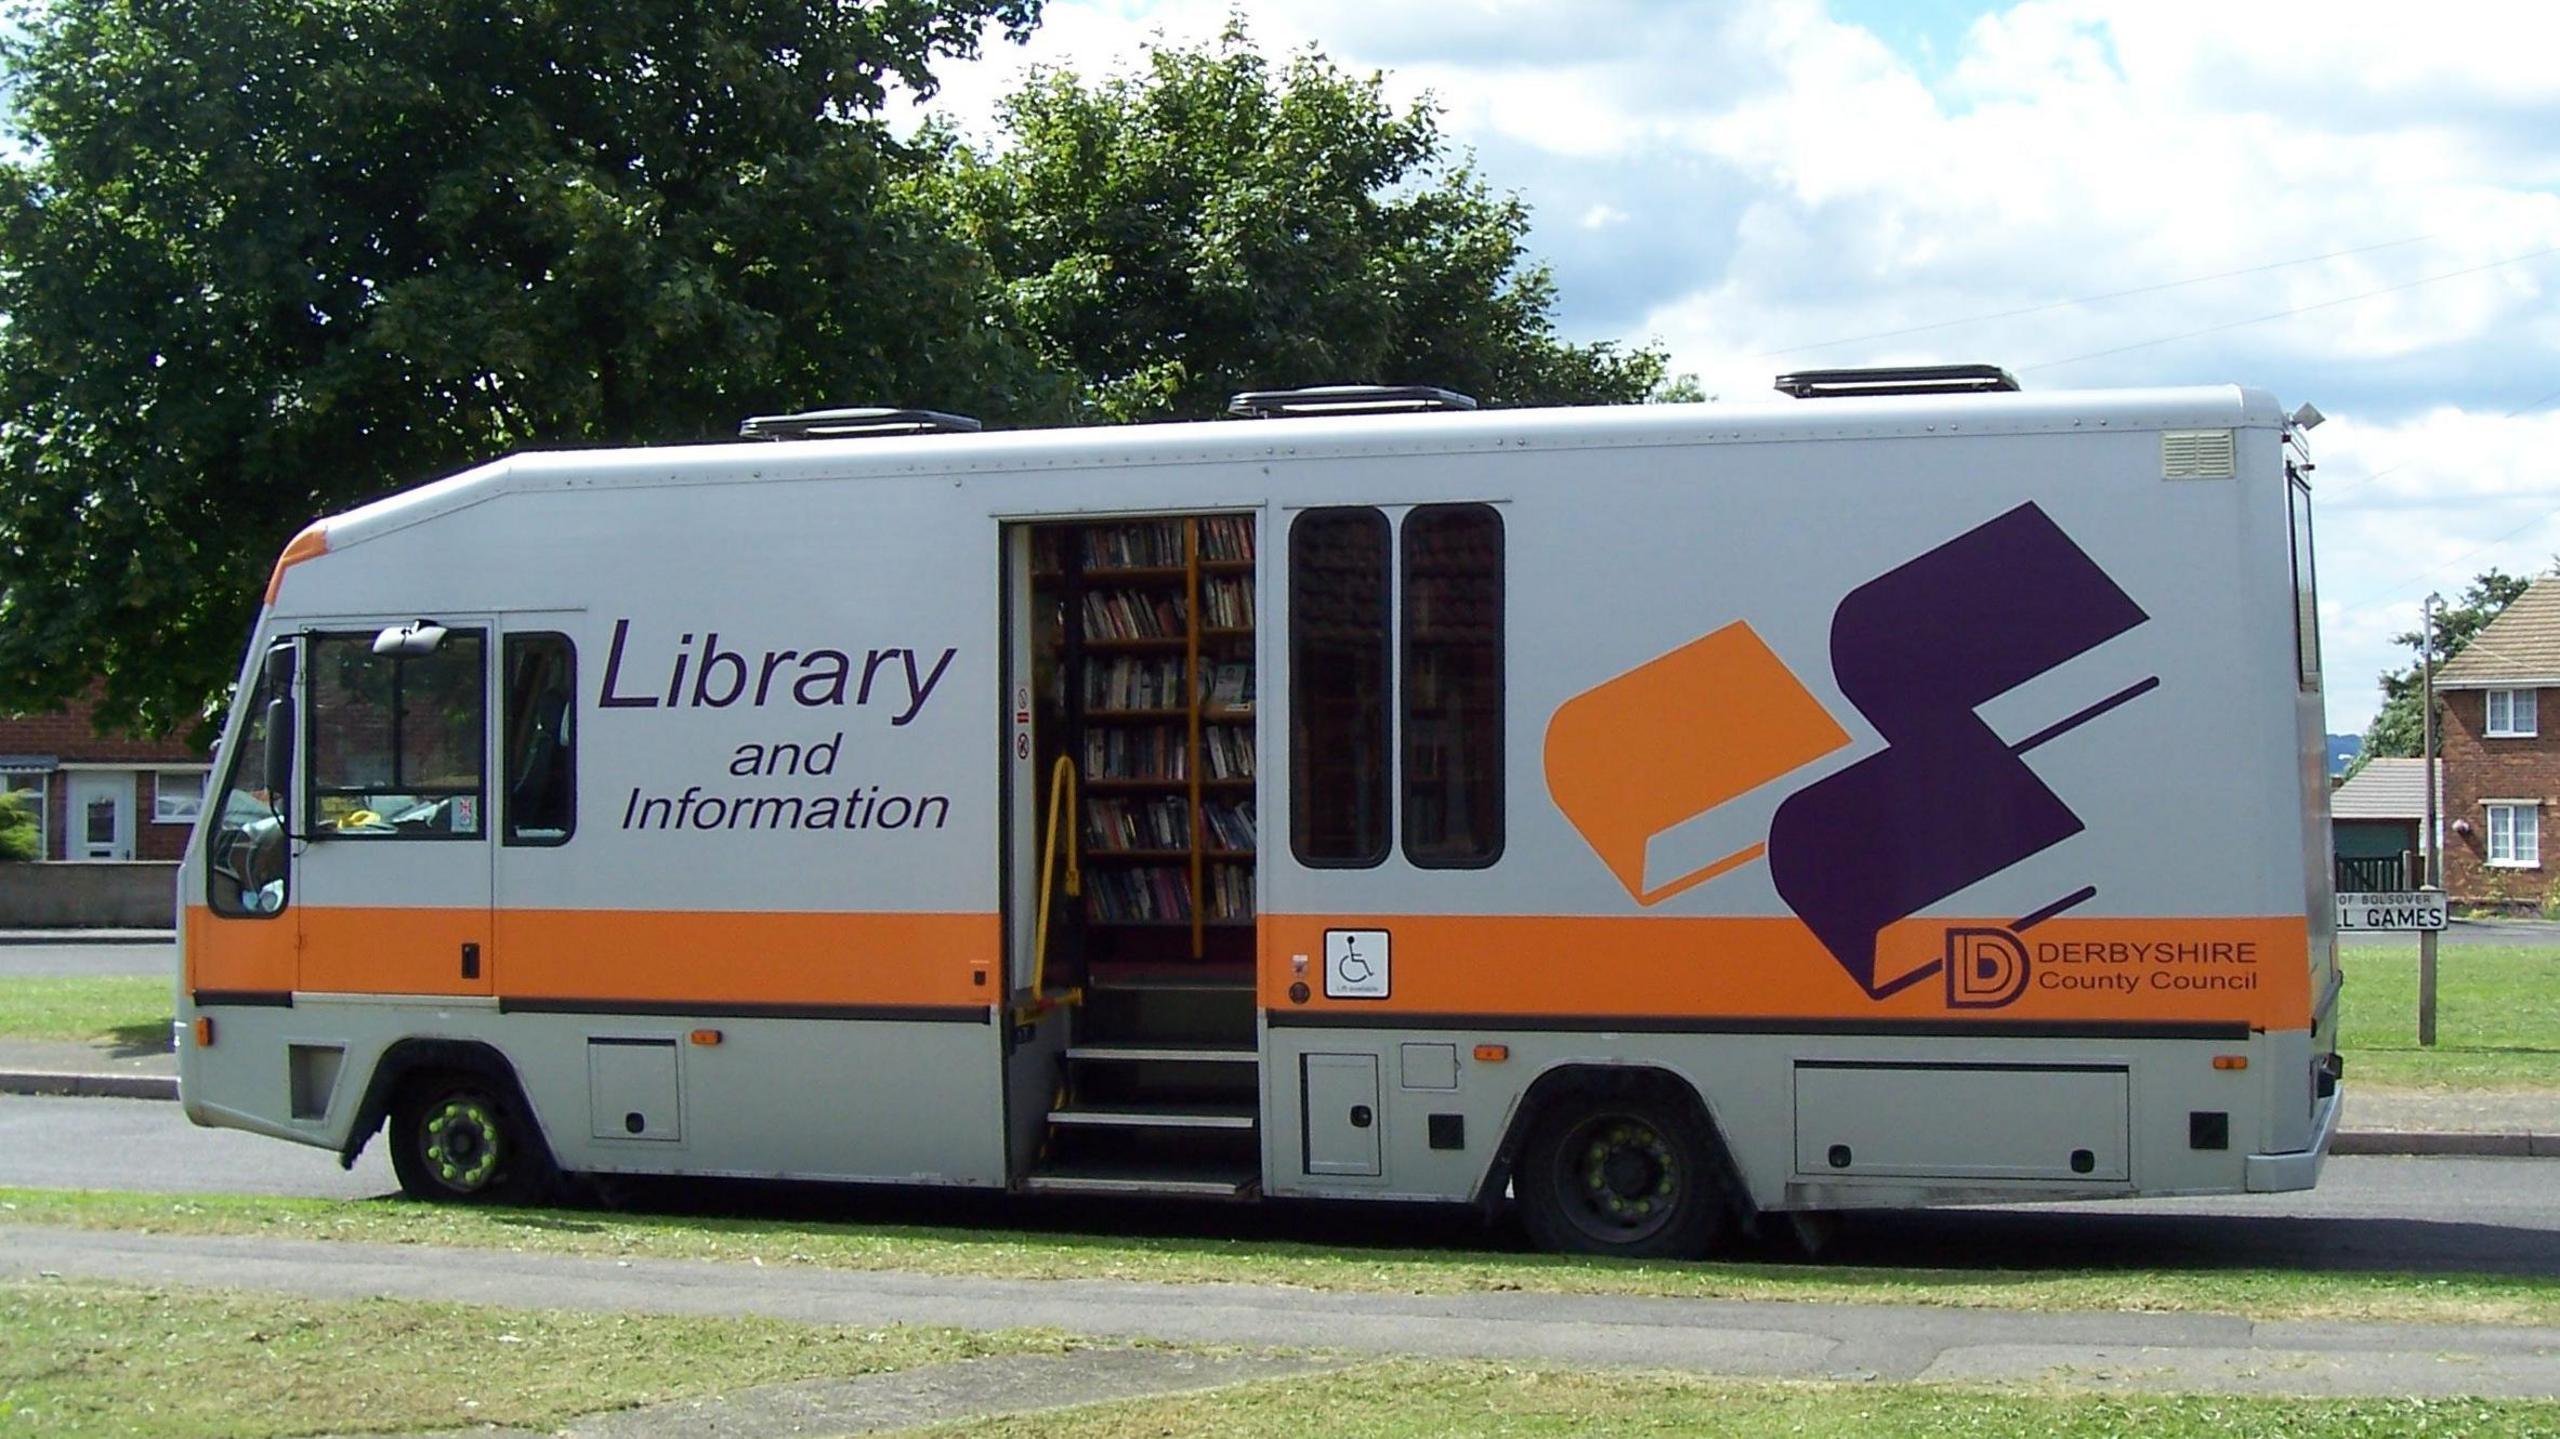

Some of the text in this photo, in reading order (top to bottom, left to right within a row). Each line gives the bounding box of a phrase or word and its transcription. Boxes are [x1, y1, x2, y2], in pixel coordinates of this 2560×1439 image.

[598, 618, 958, 727] Library
[728, 732, 844, 777] and
[621, 785, 950, 830] Information
[2338, 894, 2431, 906] OF BOLSOVER
[2336, 908, 2442, 928] L GAMES
[2037, 942, 2258, 964] DERBYSHIRE
[2038, 970, 2258, 994] County Council
